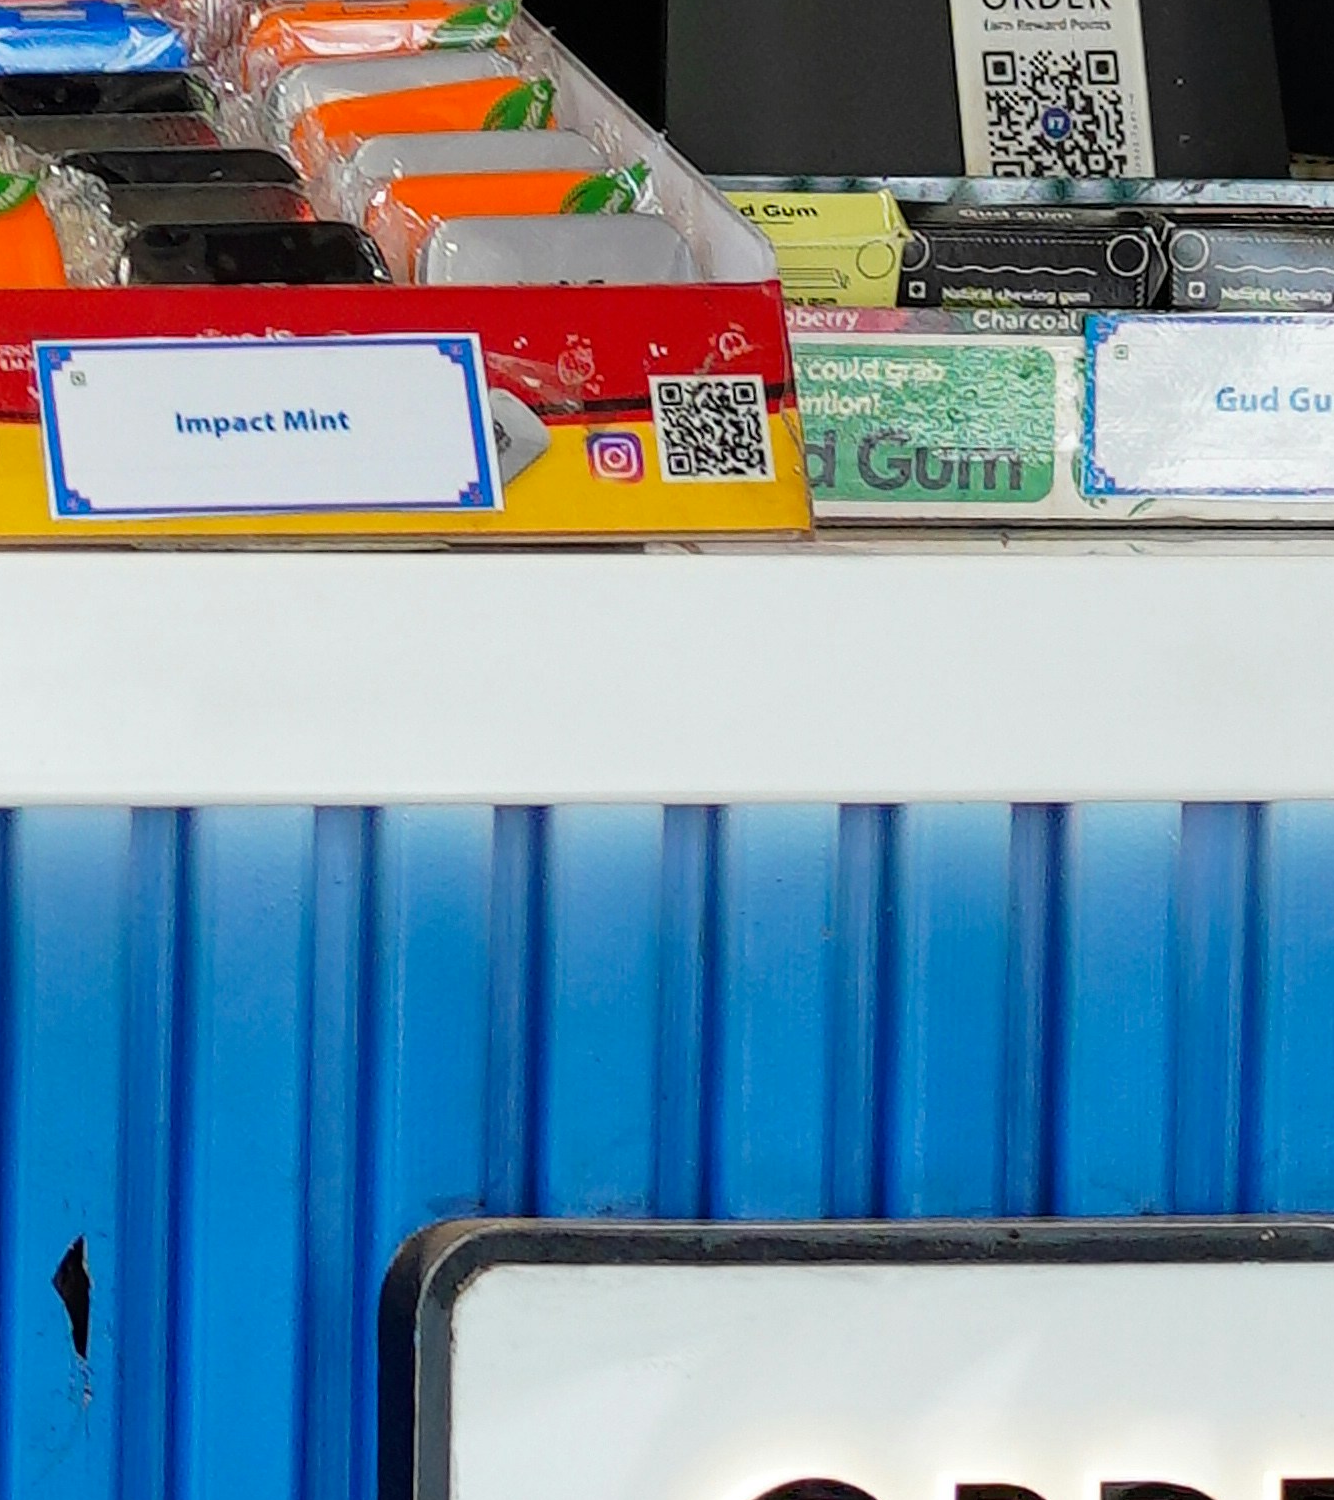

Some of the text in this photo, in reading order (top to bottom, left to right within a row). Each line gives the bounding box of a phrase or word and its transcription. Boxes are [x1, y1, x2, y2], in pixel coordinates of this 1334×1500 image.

[1017, 19, 1068, 31] Reward
[763, 205, 819, 218] Gum
[996, 289, 1056, 304] chewing
[1059, 291, 1092, 304] gum
[1274, 289, 1332, 305] chewing
[973, 310, 1077, 330] Charcoal
[806, 360, 946, 388] could grab
[1214, 386, 1279, 415] Gud
[175, 409, 350, 439] Impact Mint
[857, 429, 1022, 491] Gum
